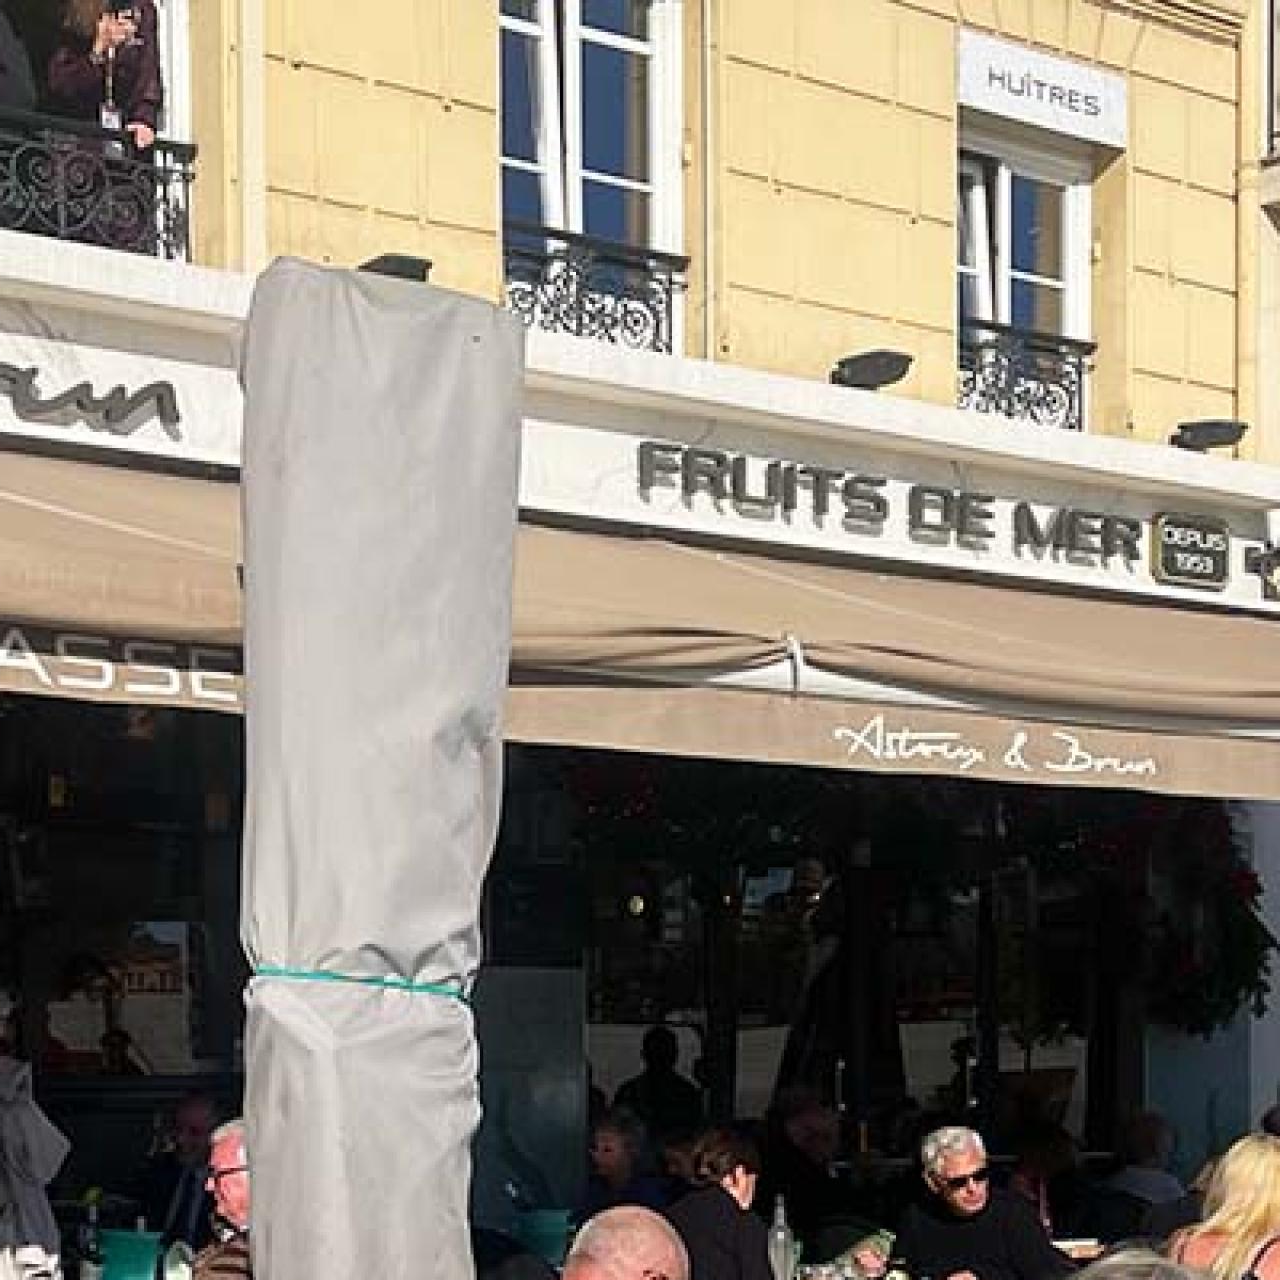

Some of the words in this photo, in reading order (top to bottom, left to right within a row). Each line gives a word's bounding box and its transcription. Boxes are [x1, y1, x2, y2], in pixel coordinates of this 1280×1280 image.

[988, 66, 1101, 116] HUÎTRES
[636, 440, 889, 530] FRUITS
[908, 483, 995, 543] DE
[1013, 502, 1142, 568] MER
[1163, 525, 1226, 551] DEPUIS
[1004, 731, 1027, 768] &
[1045, 736, 1158, 776] Brun
